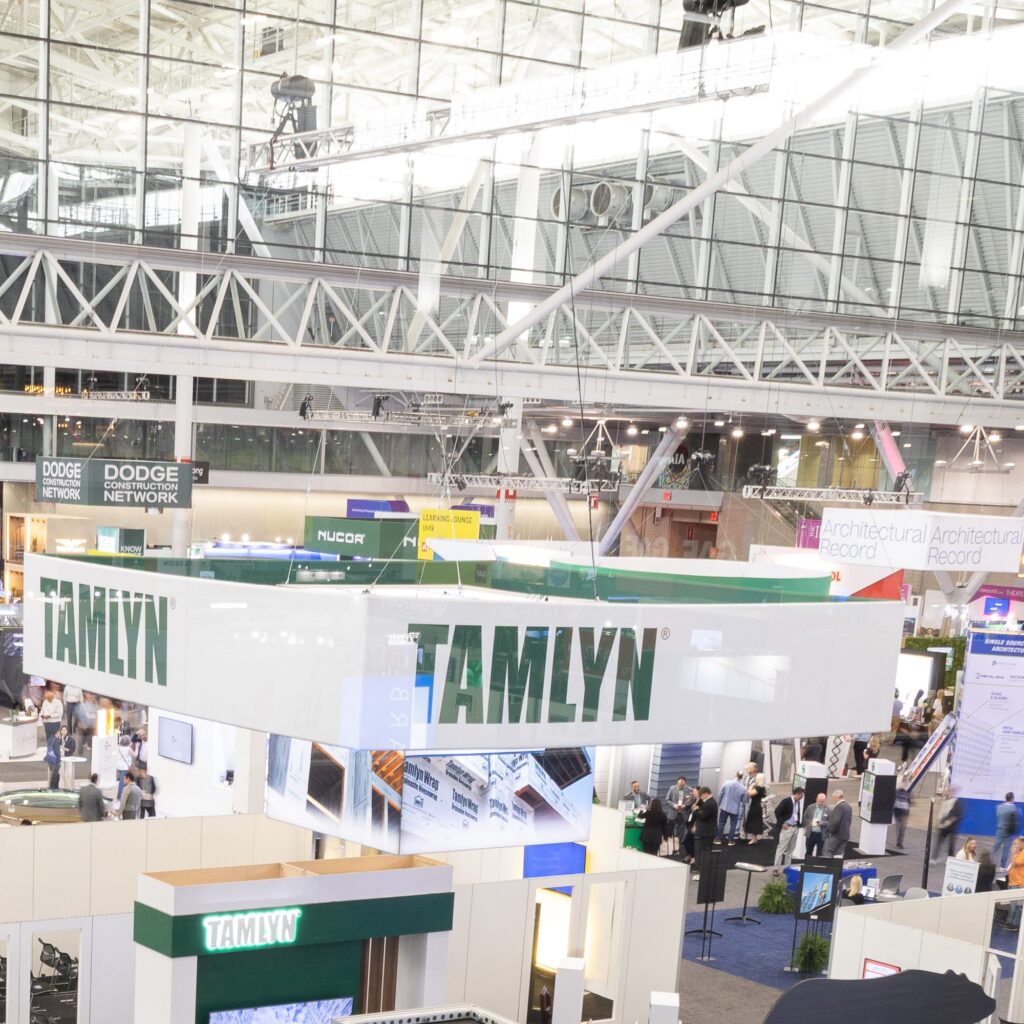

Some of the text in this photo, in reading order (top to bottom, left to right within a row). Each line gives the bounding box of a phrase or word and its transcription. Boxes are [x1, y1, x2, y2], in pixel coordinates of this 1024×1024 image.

[42, 461, 81, 478] DODGE
[104, 464, 179, 482] DODGE
[42, 478, 81, 487] CONSTRUCTION
[104, 481, 179, 490] CONSTRUCTION
[42, 488, 81, 500] NETWORK
[103, 490, 179, 504] NETWORK
[422, 513, 450, 523] LEARNING
[317, 530, 366, 544] NUCOR
[823, 518, 927, 545] Architectural
[930, 525, 1024, 545] Architectural
[120, 545, 142, 553] KNOW
[820, 538, 878, 560] Record
[927, 547, 983, 565] Record
[40, 576, 168, 687] TAMLYN
[408, 623, 658, 725] TAMLYN
[207, 911, 297, 948] TAMLYN
